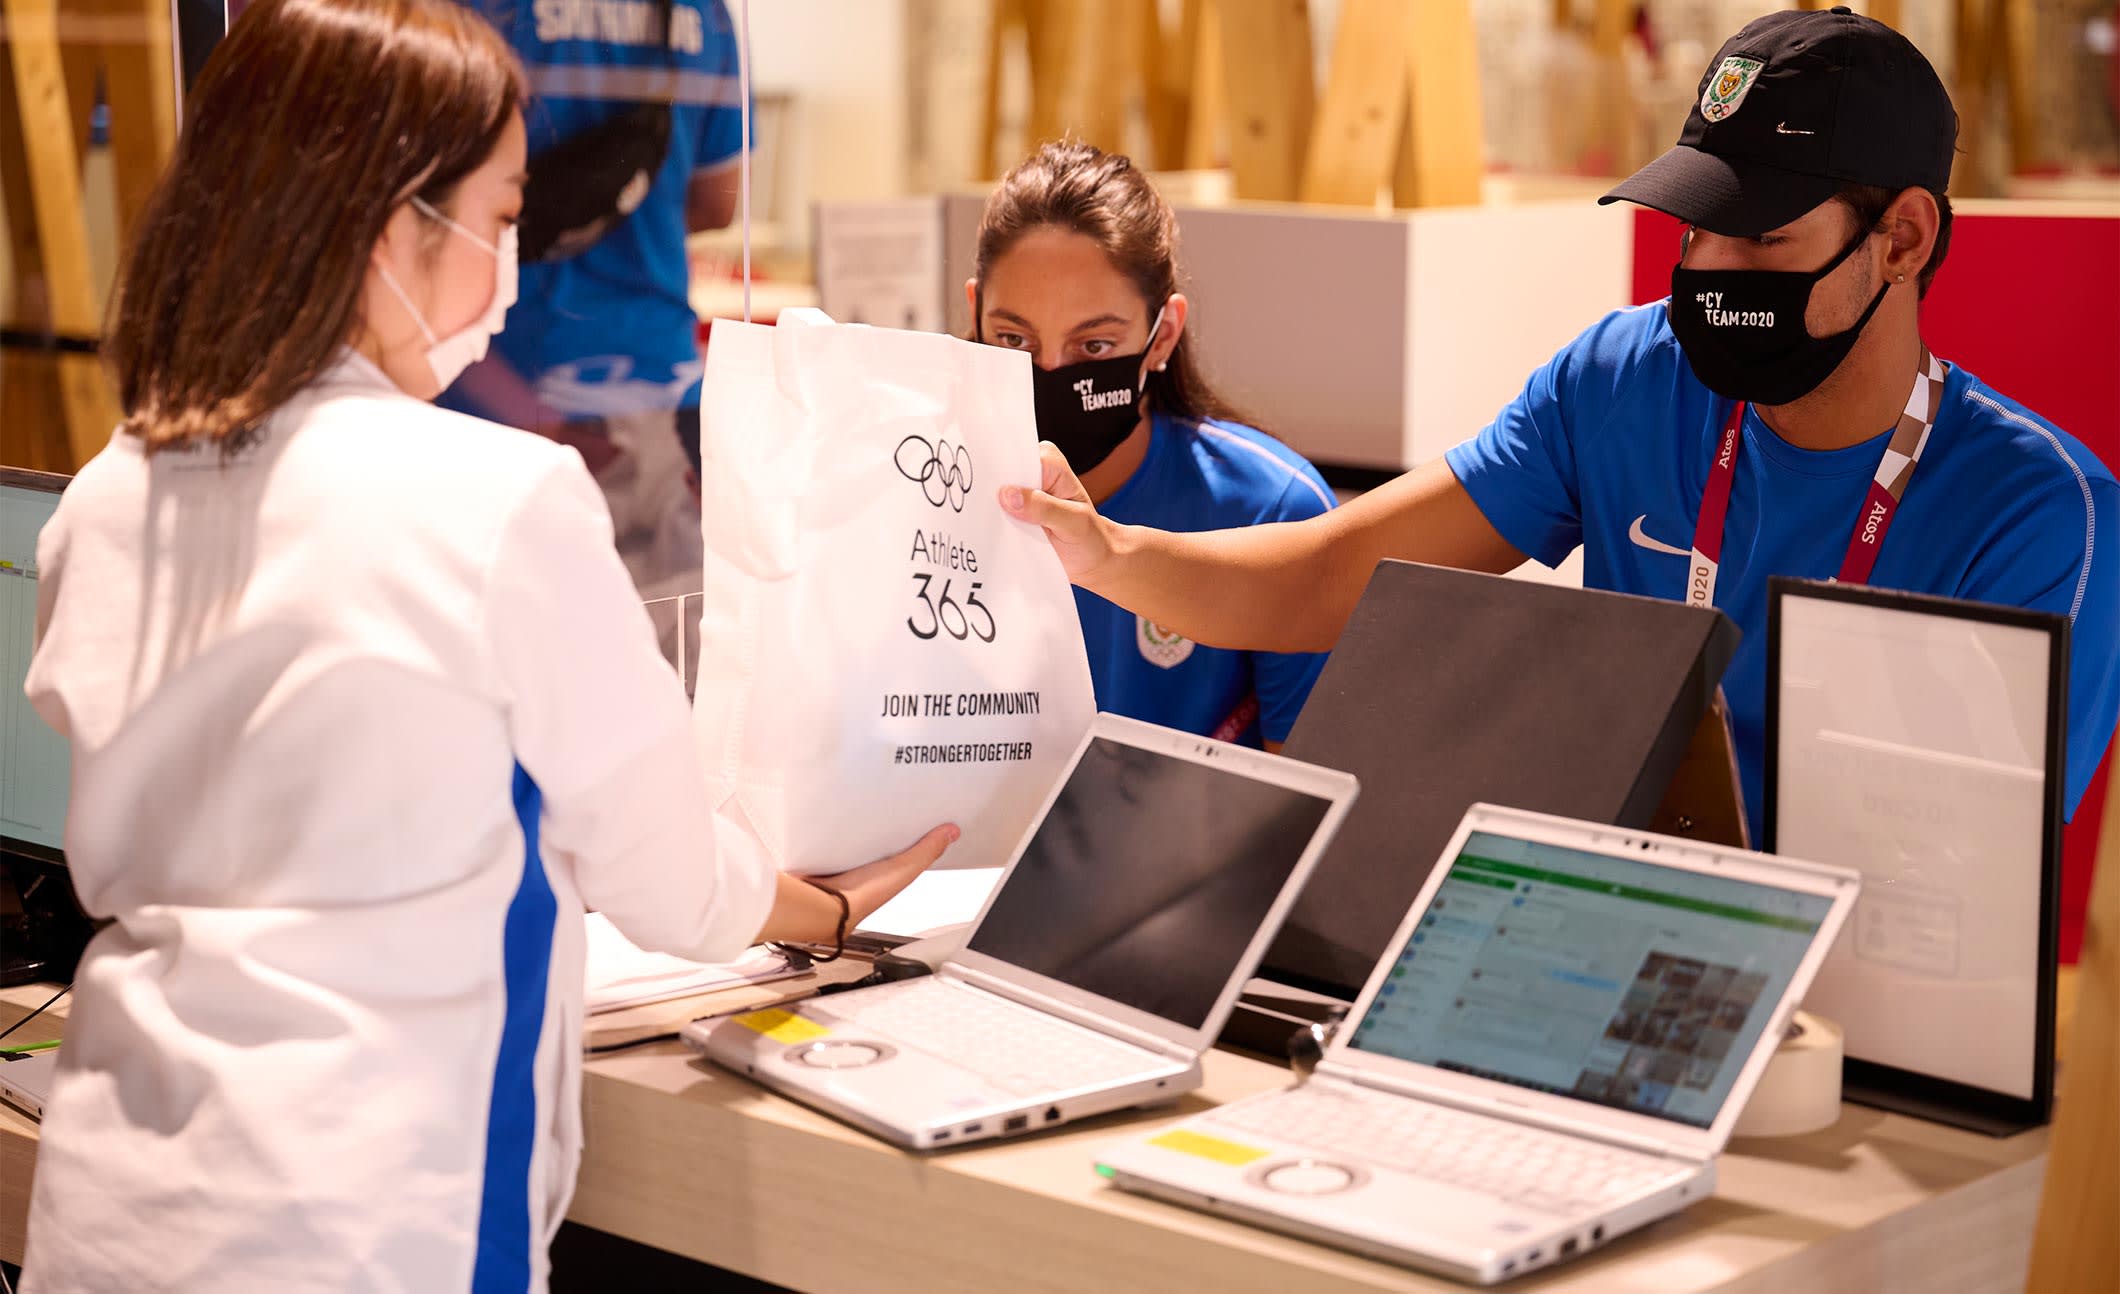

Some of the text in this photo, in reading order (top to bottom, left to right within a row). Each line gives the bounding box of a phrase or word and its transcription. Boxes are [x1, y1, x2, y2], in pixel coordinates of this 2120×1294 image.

[1724, 59, 1761, 71] CYPRUS
[1695, 291, 1723, 308] #CY
[1718, 429, 1735, 470] Atos
[1862, 501, 1887, 544] Atos
[910, 529, 978, 573] Athlete
[907, 573, 996, 643] 365
[882, 691, 1041, 717] JOIN THE COMMUNITY
[894, 742, 1033, 764] #STRONGERTOGETHER
